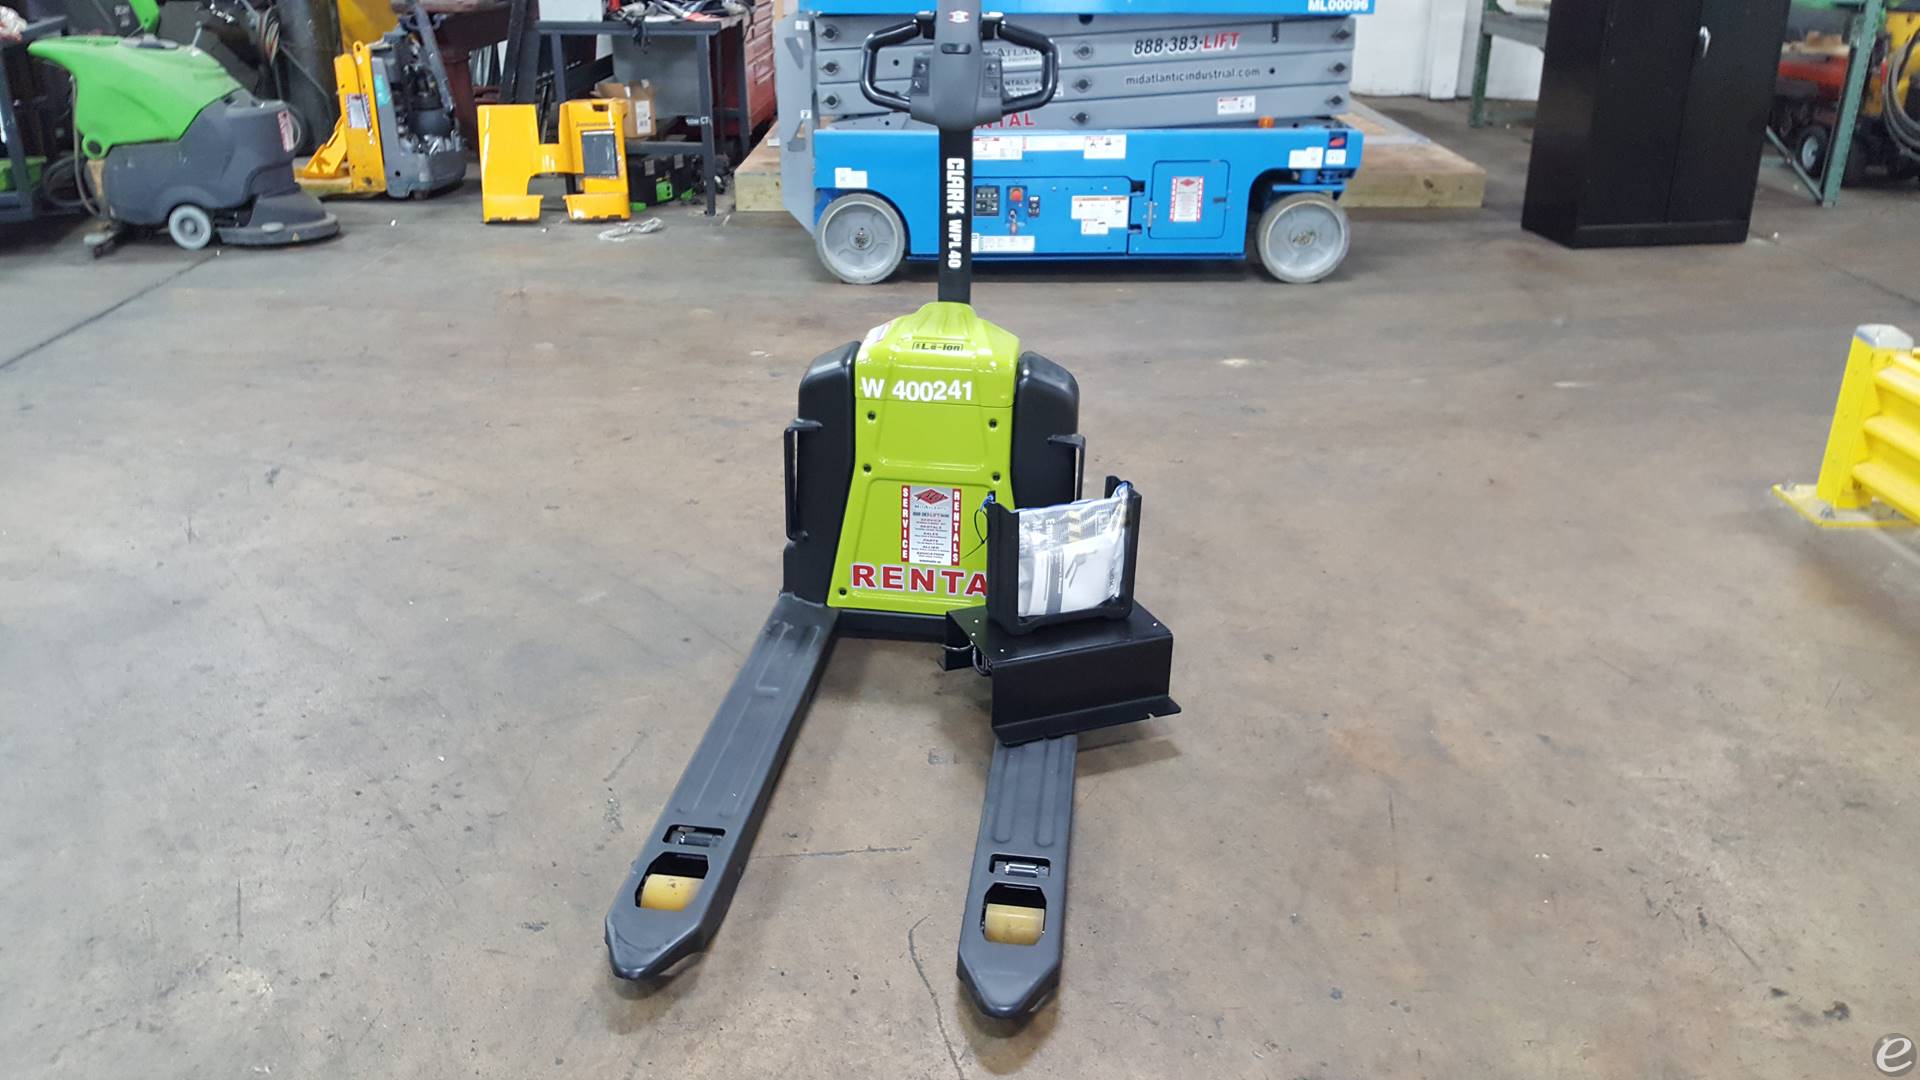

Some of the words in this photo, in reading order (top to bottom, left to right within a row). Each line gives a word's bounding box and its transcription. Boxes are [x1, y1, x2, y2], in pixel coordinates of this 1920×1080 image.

[1126, 67, 1260, 85] midatlanticindustrial.com
[946, 158, 965, 214] CLARK
[861, 377, 885, 399] W
[892, 380, 973, 401] 400241
[952, 490, 960, 562] RENTALS
[851, 563, 987, 597] RENTA
